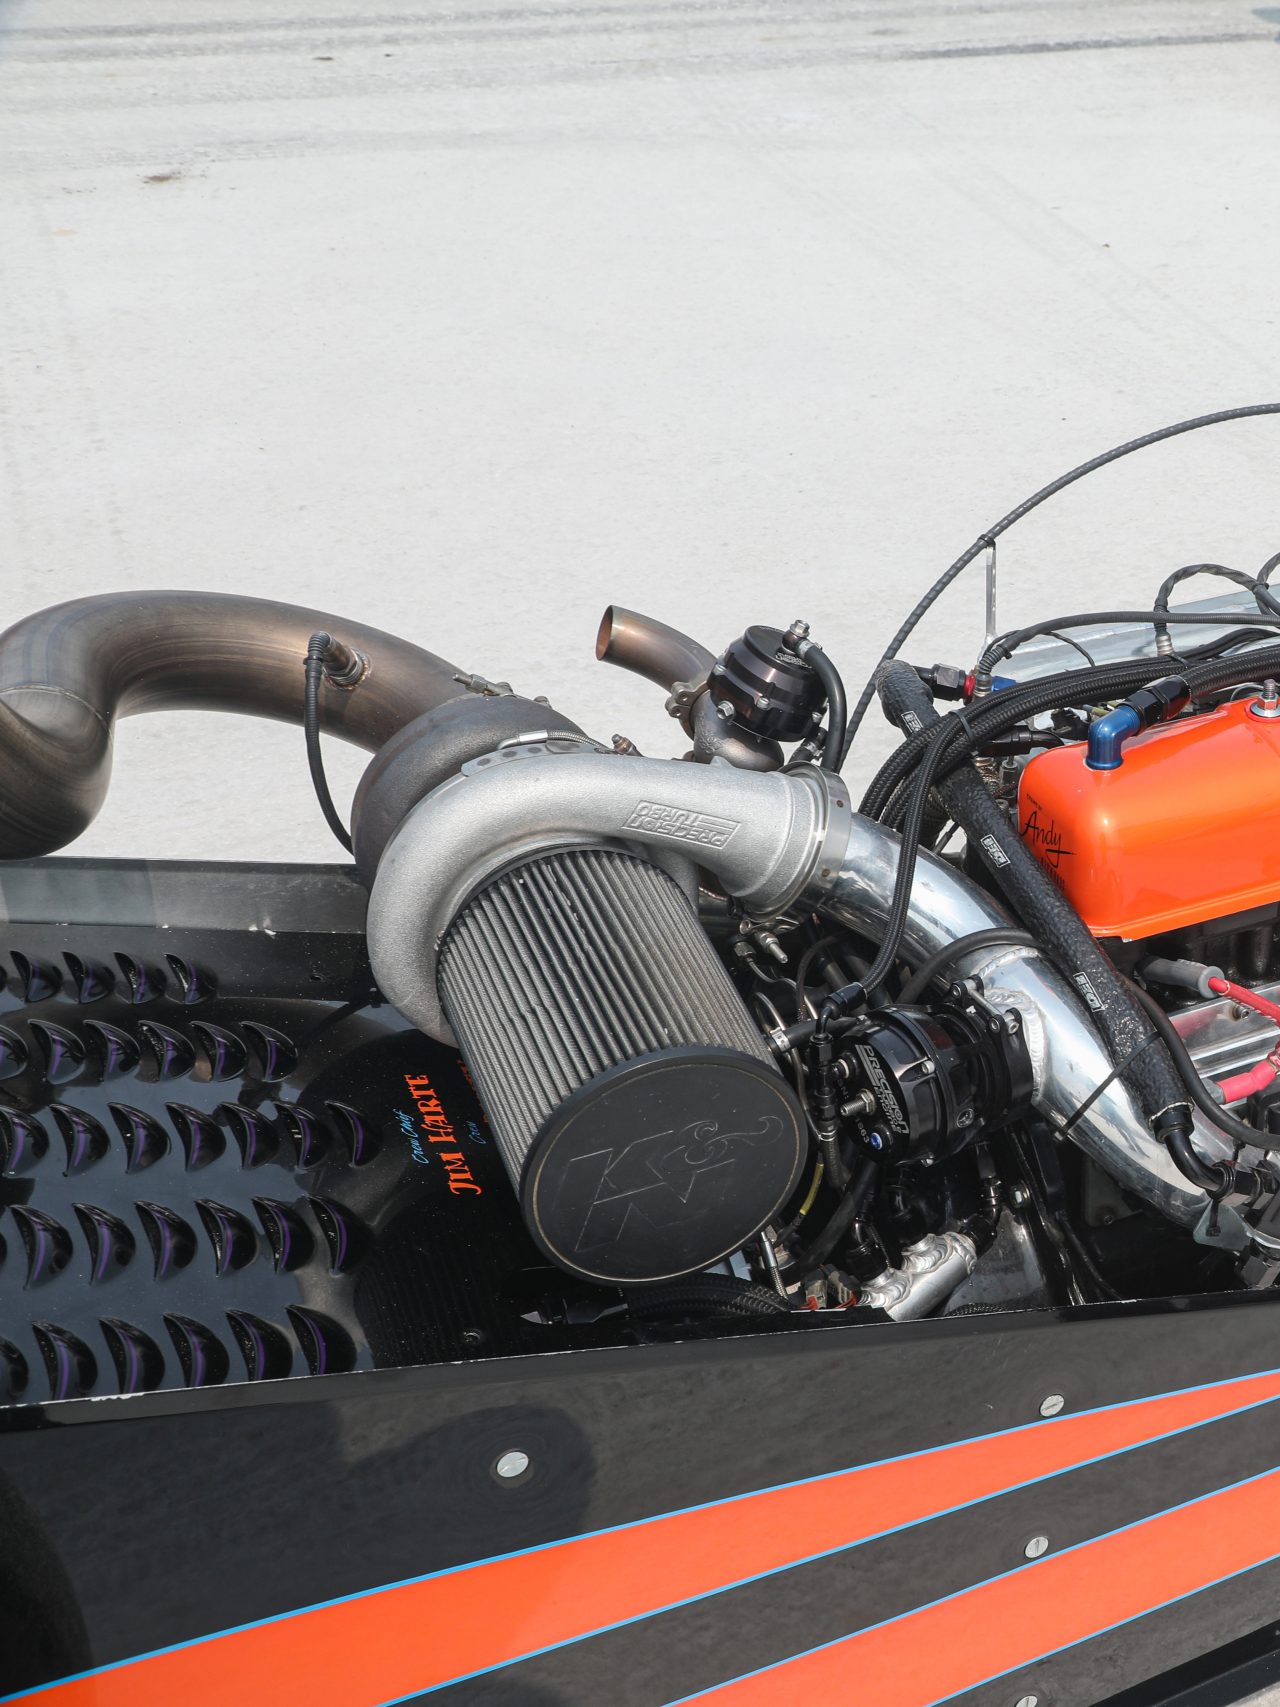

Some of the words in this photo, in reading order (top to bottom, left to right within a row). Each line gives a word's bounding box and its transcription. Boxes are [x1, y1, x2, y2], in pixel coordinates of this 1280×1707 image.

[630, 814, 729, 846] PRECISION
[637, 802, 704, 827] TURBO
[1021, 811, 1077, 869] Andy
[403, 1074, 457, 1143] HARTE
[864, 1045, 909, 1134] PRECISION
[440, 1151, 483, 1195] JIM
